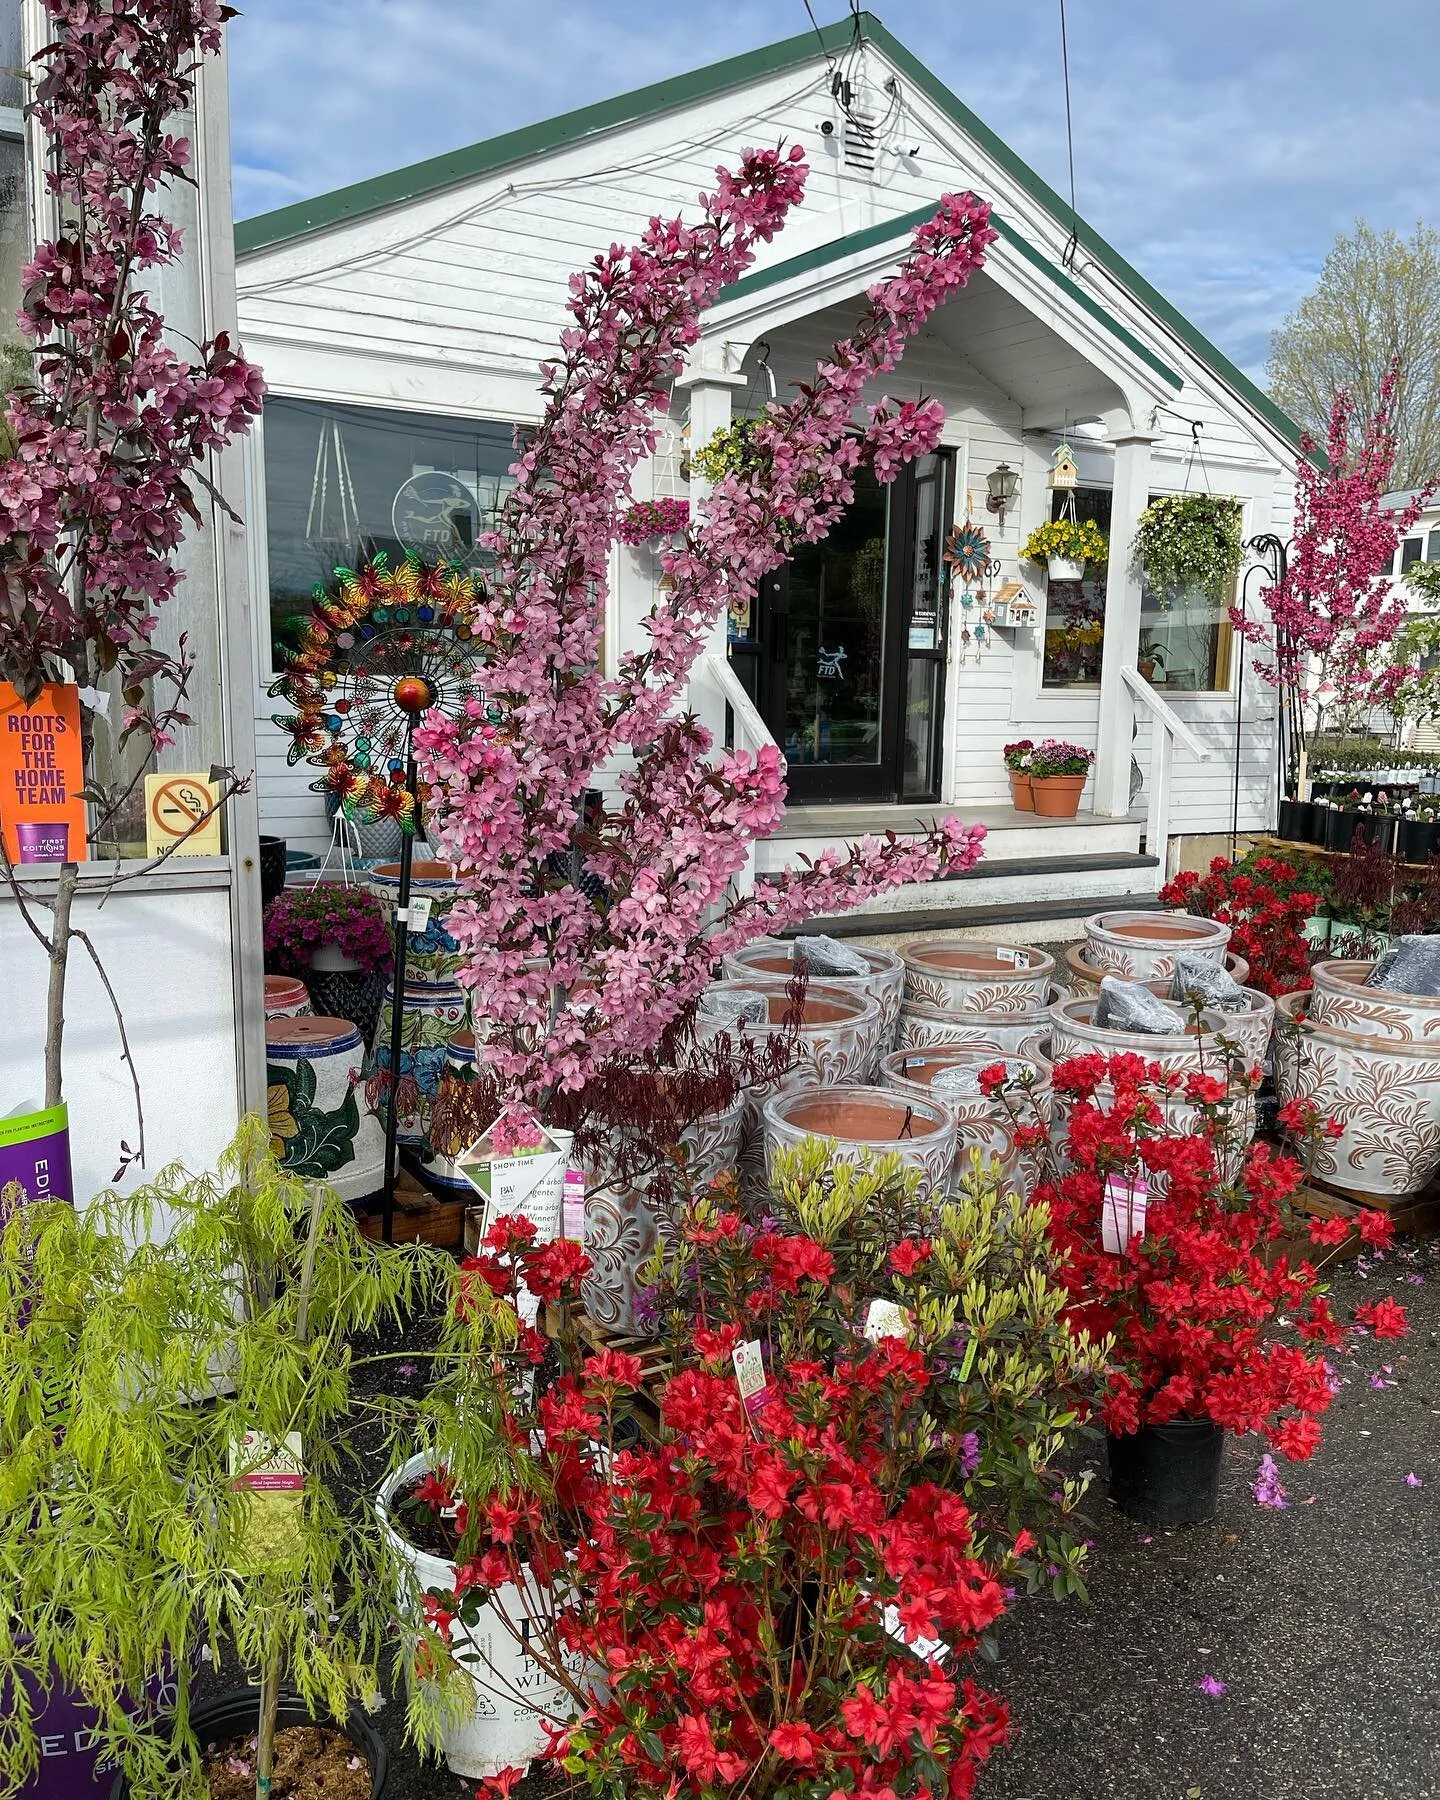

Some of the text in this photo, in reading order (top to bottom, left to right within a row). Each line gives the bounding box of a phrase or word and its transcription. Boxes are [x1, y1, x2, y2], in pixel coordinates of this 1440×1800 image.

[423, 529, 450, 541] FTD
[818, 665, 836, 675] FTD
[8, 715, 67, 733] ROOTS
[21, 734, 56, 751] FOR
[22, 752, 57, 769] THE
[15, 770, 66, 787] HOME
[16, 788, 66, 805] TEAM
[22, 844, 65, 853] EDITIONS
[493, 1161, 516, 1170] SHOW
[517, 1158, 535, 1167] TIME
[531, 1189, 556, 1198] gente.
[479, 1701, 486, 1709] 5
